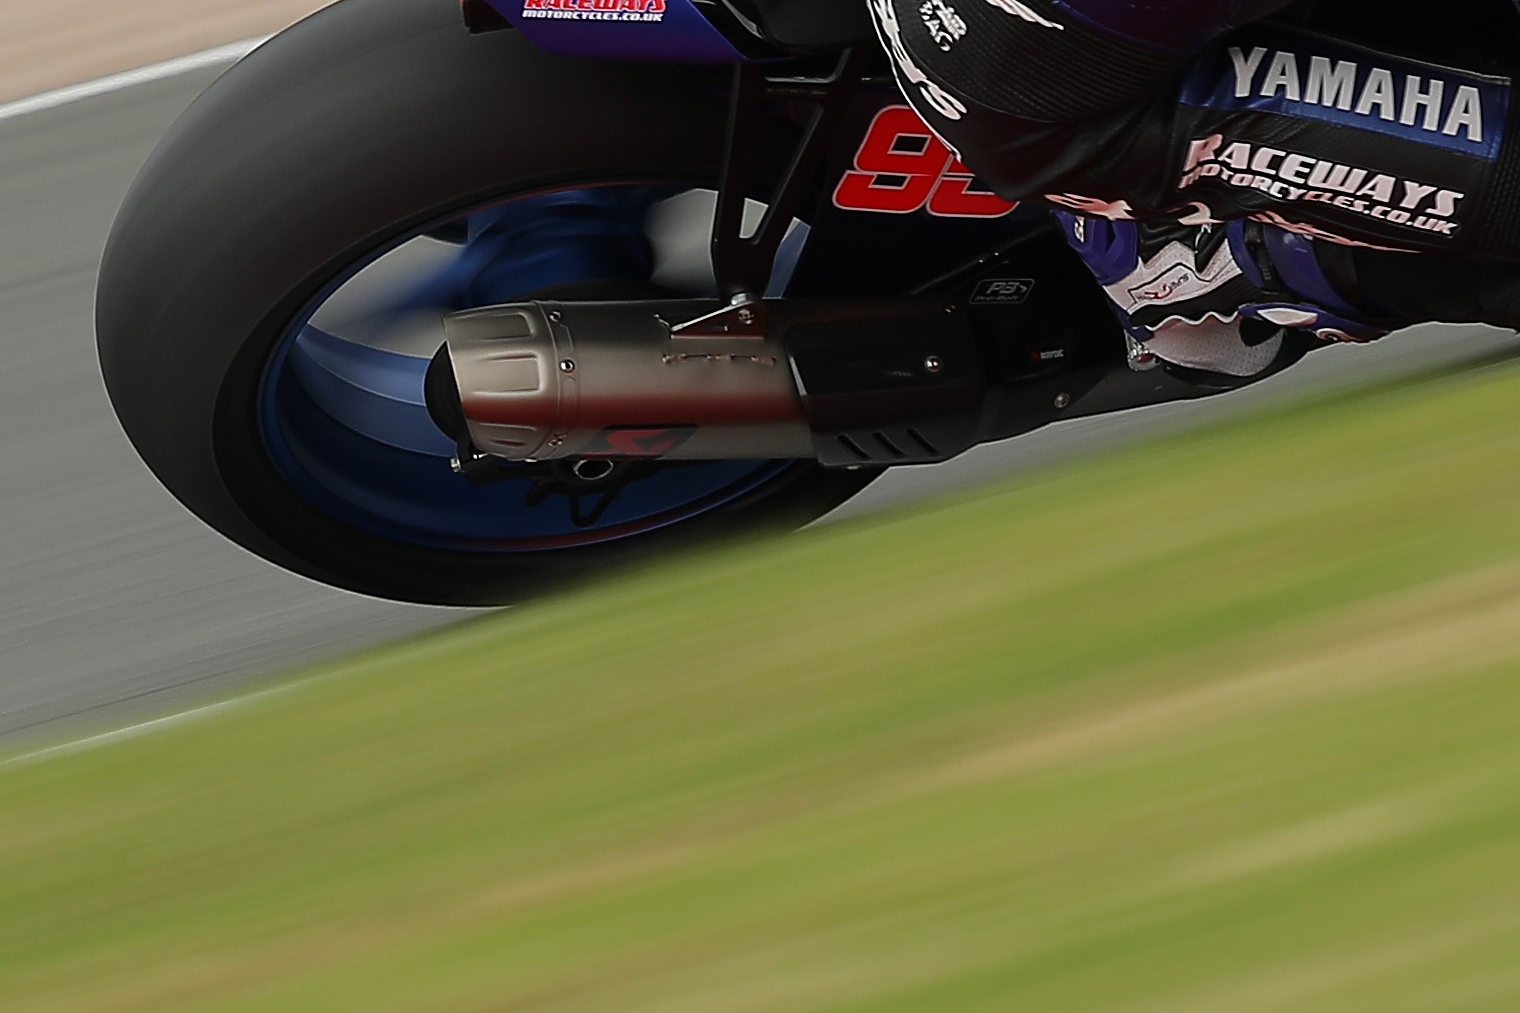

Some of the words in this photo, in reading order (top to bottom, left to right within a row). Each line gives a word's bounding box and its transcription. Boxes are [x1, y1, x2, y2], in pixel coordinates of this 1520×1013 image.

[521, 8, 664, 23] MOTORCYCLES.CO.UK
[1228, 45, 1484, 143] YAMAHA
[1181, 133, 1465, 218] RACEWAYS
